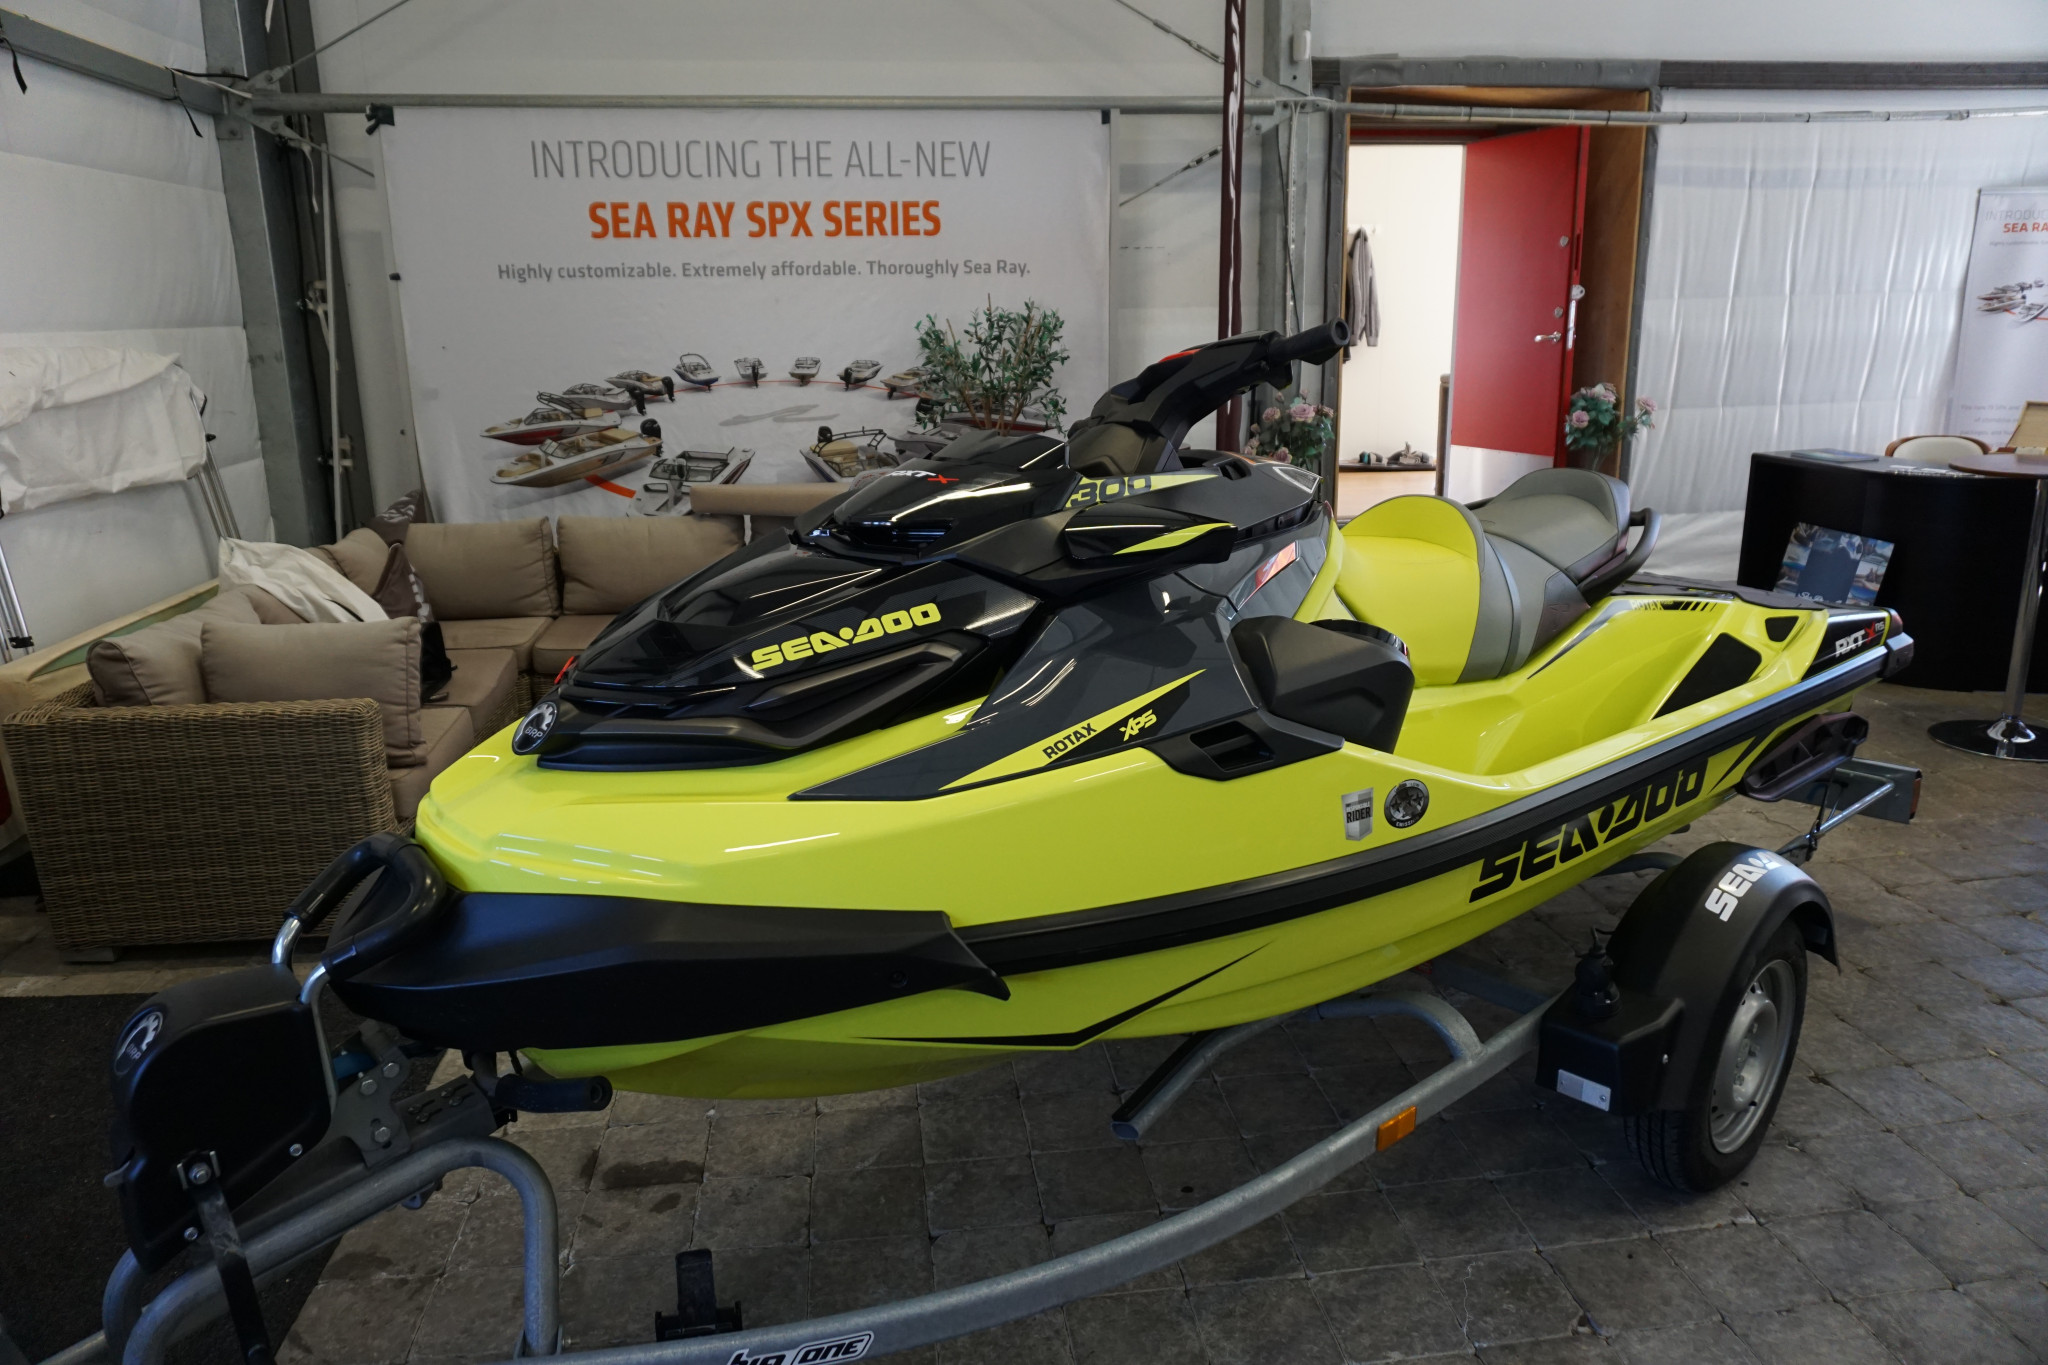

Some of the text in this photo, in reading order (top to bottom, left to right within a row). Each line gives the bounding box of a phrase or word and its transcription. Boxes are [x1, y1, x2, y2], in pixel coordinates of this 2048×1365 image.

[531, 140, 990, 178] INTRODUCING THE ALL-NEW
[588, 200, 941, 239] SEA RAY SPX SERIES
[2003, 222, 2028, 233] SEA
[498, 259, 1031, 283] Highly customizable. Extremely affordable. Thoroughly Sea Ray.
[1072, 475, 1151, 505] 300
[525, 726, 543, 738] BRP
[1119, 709, 1157, 741] XPS
[1042, 723, 1097, 759] ROTAX
[1346, 807, 1371, 823] RIDER
